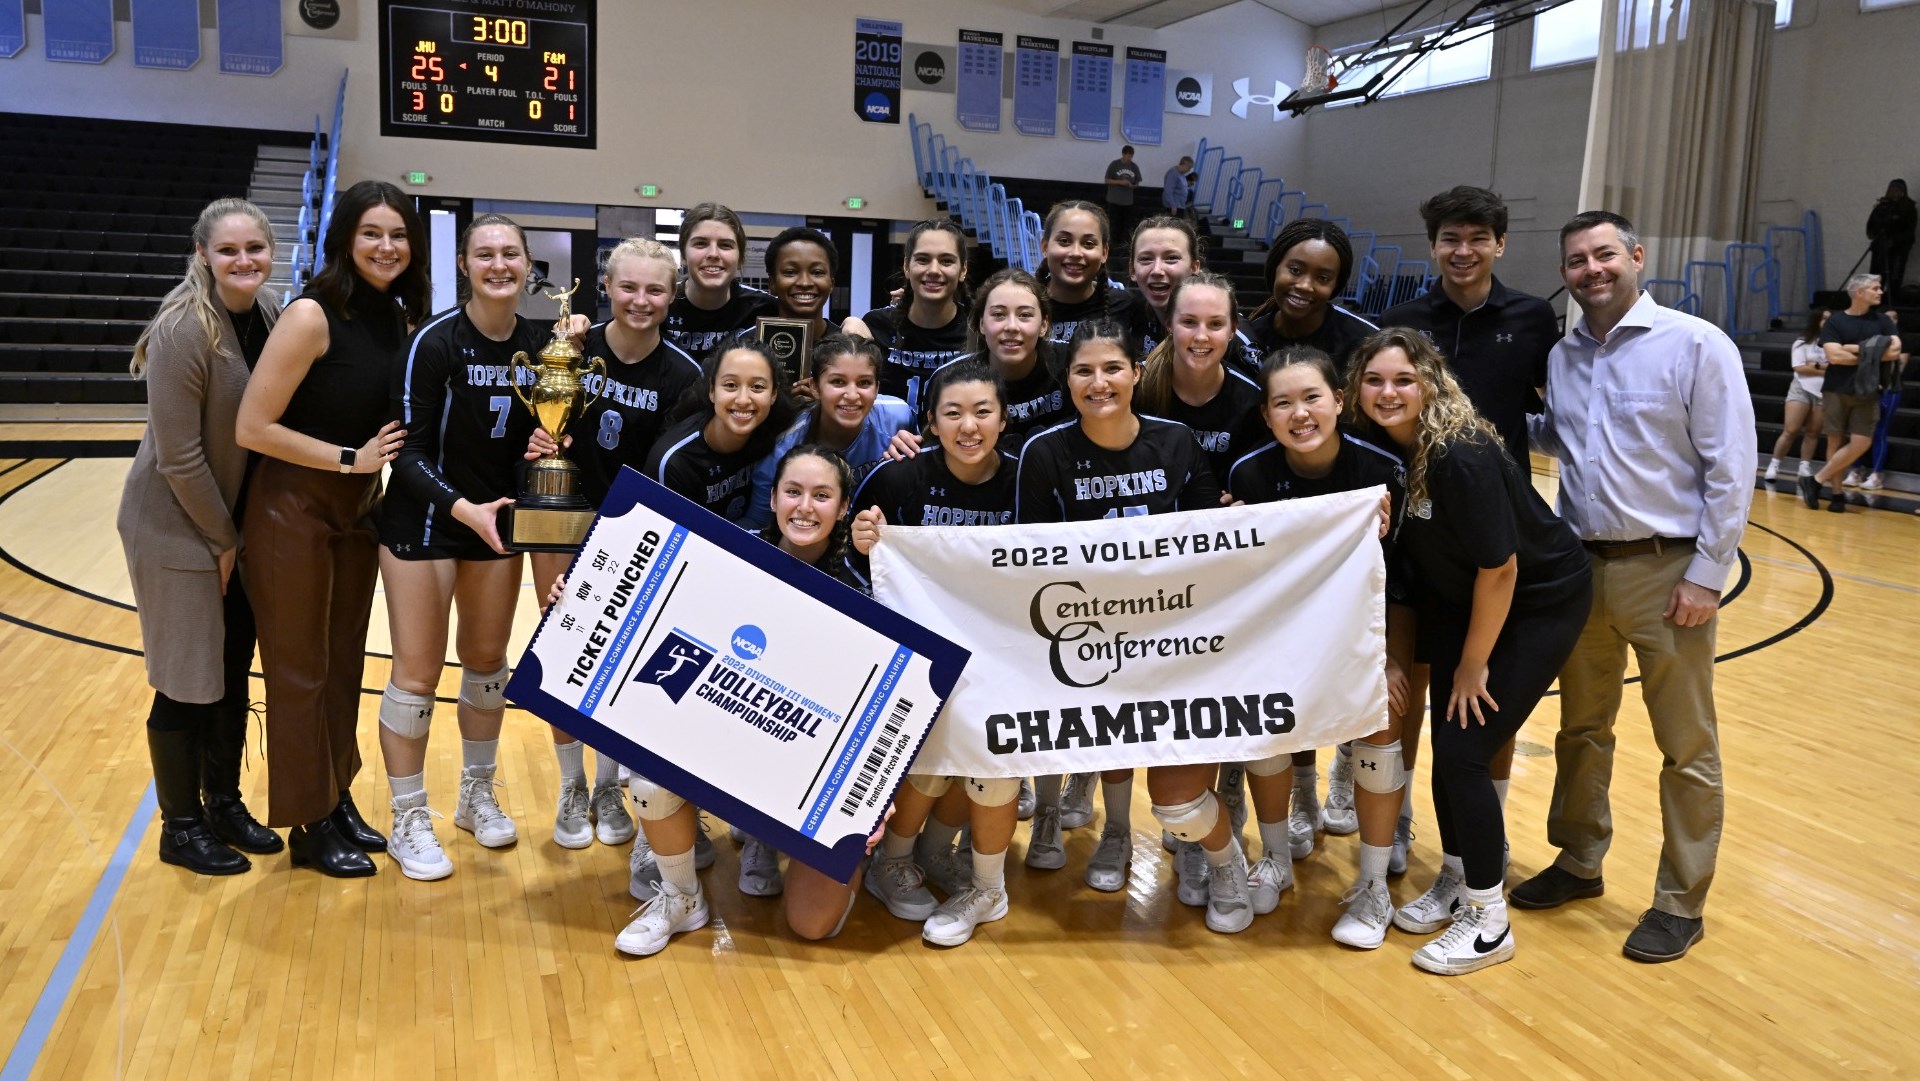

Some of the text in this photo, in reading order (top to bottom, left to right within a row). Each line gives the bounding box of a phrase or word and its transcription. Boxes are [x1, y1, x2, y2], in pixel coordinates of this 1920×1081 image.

[474, 17, 526, 44] 3:00
[963, 35, 998, 44] BASKETBALL
[416, 41, 436, 54] JHU
[477, 53, 505, 62] PERIOD
[856, 40, 901, 62] 2019
[544, 52, 566, 64] F&M
[412, 56, 444, 81] 25
[485, 65, 498, 82] 4
[544, 67, 574, 90] 21
[856, 64, 900, 77] NATIONAL
[917, 66, 944, 77] NCAA
[402, 82, 427, 91] FOULS
[436, 84, 458, 93] T.O.L.
[466, 87, 518, 98] PLAYER FOUL
[856, 76, 900, 89] CHAMPIONS
[413, 91, 424, 111] 3
[440, 94, 454, 113] 0
[525, 91, 546, 100] T.O.L.
[554, 93, 578, 102] FOULS
[1178, 91, 1201, 100] NCAA
[402, 113, 428, 123] SCORE
[529, 100, 542, 119] 0
[569, 104, 574, 120] 1
[866, 105, 890, 114] NCAA
[478, 119, 505, 128] MATCH
[554, 124, 577, 133] SCORE
[490, 396, 512, 438] 7
[597, 409, 623, 450] 8
[1075, 469, 1167, 500] HOPKINS
[992, 528, 1266, 567] 2022 VOLLEYBALL
[561, 549, 610, 630] SEC ROW SEAT
[593, 594, 602, 602] 6
[608, 560, 620, 574] 22
[566, 530, 660, 687] TICKET PUNCHED
[1030, 580, 1196, 642] Centennial
[586, 532, 682, 709] CENTENNIAL CONFERENCE AUTOMATIC QUALIFIER
[733, 636, 762, 656] NCAA
[1049, 620, 1225, 688] Conference
[722, 655, 842, 723] 2022 DIVISION III WOMEN'S
[707, 663, 822, 738] VOLLEYBALL
[695, 683, 798, 743] CHAMPIONSHIP
[985, 692, 1296, 755] CHAMPIONS
[808, 653, 906, 830] CENTENNIAL CONFERENCE AUTOMATIC QUALIFIER
[866, 774, 889, 808] #centconf
[883, 755, 900, 776] #ccvb
